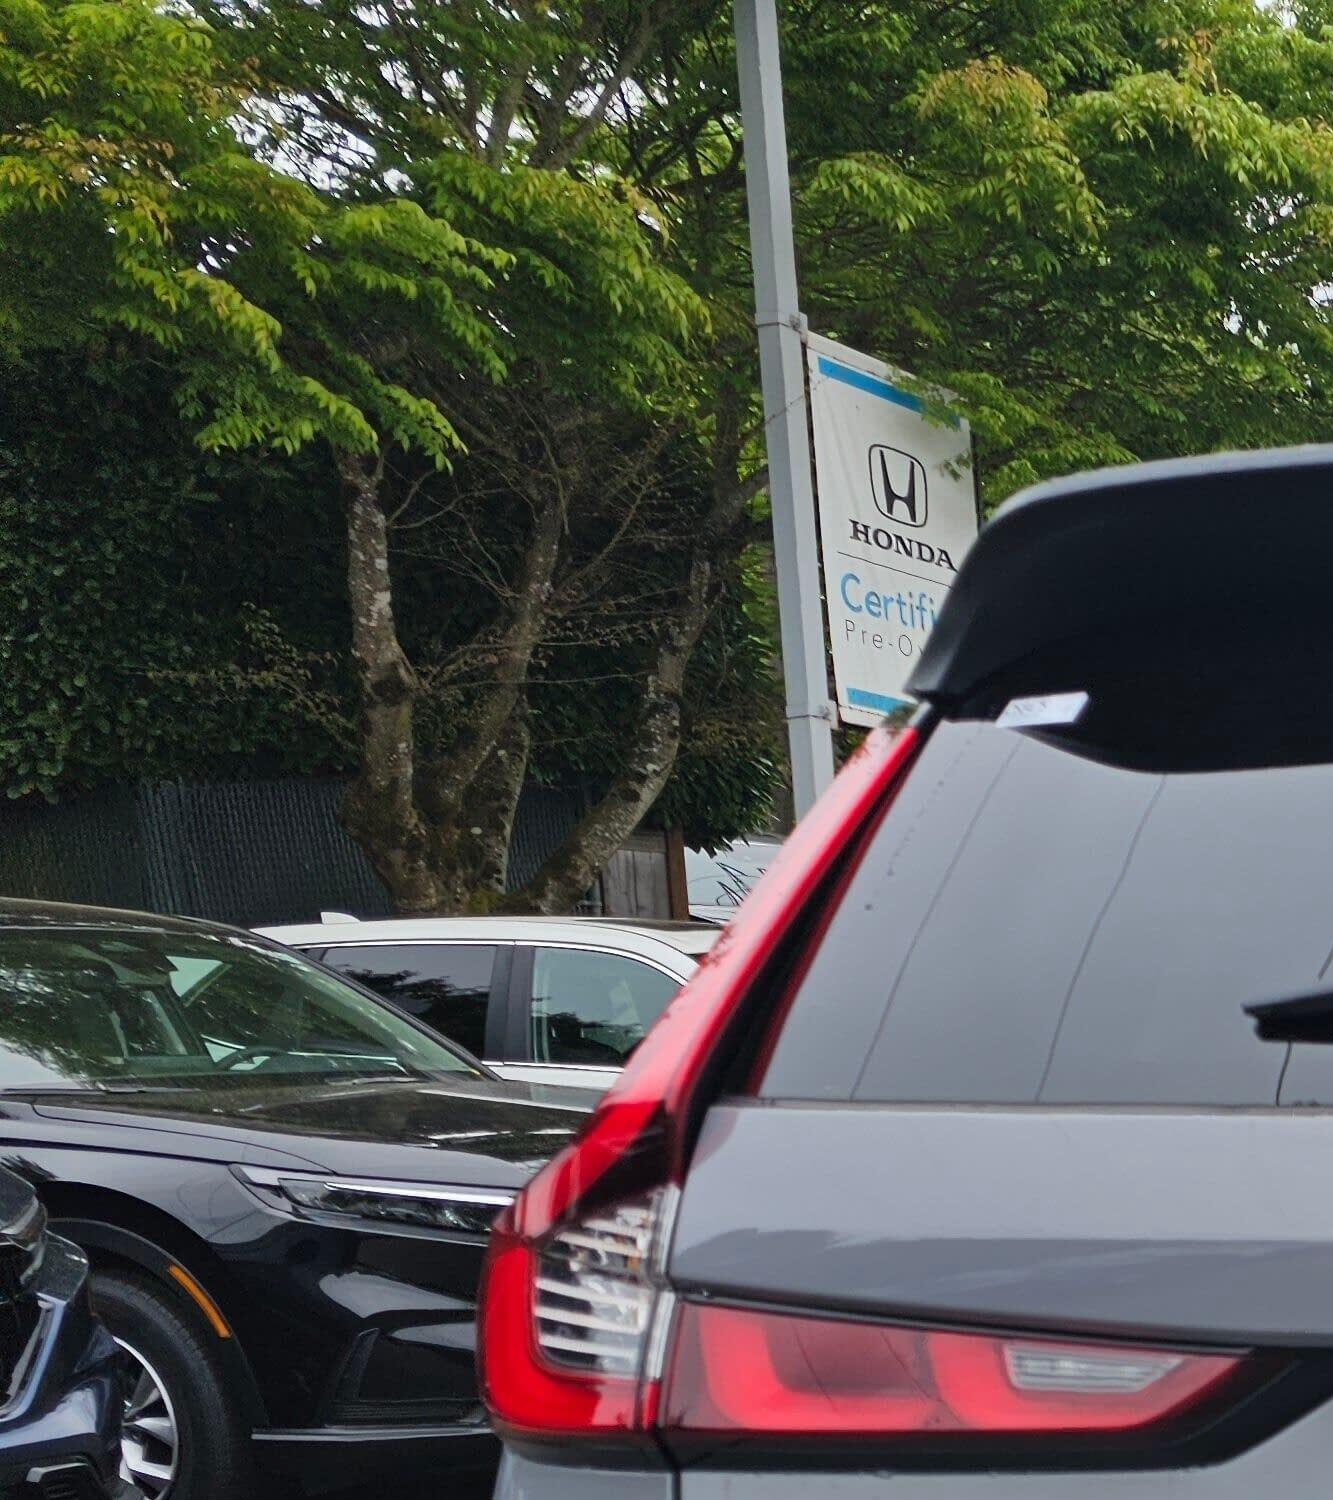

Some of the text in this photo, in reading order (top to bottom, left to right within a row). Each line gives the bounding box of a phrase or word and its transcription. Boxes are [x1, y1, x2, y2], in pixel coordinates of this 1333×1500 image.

[848, 518, 958, 573] HONDA
[840, 572, 938, 633] Certifi
[844, 618, 926, 658] Pre-O
